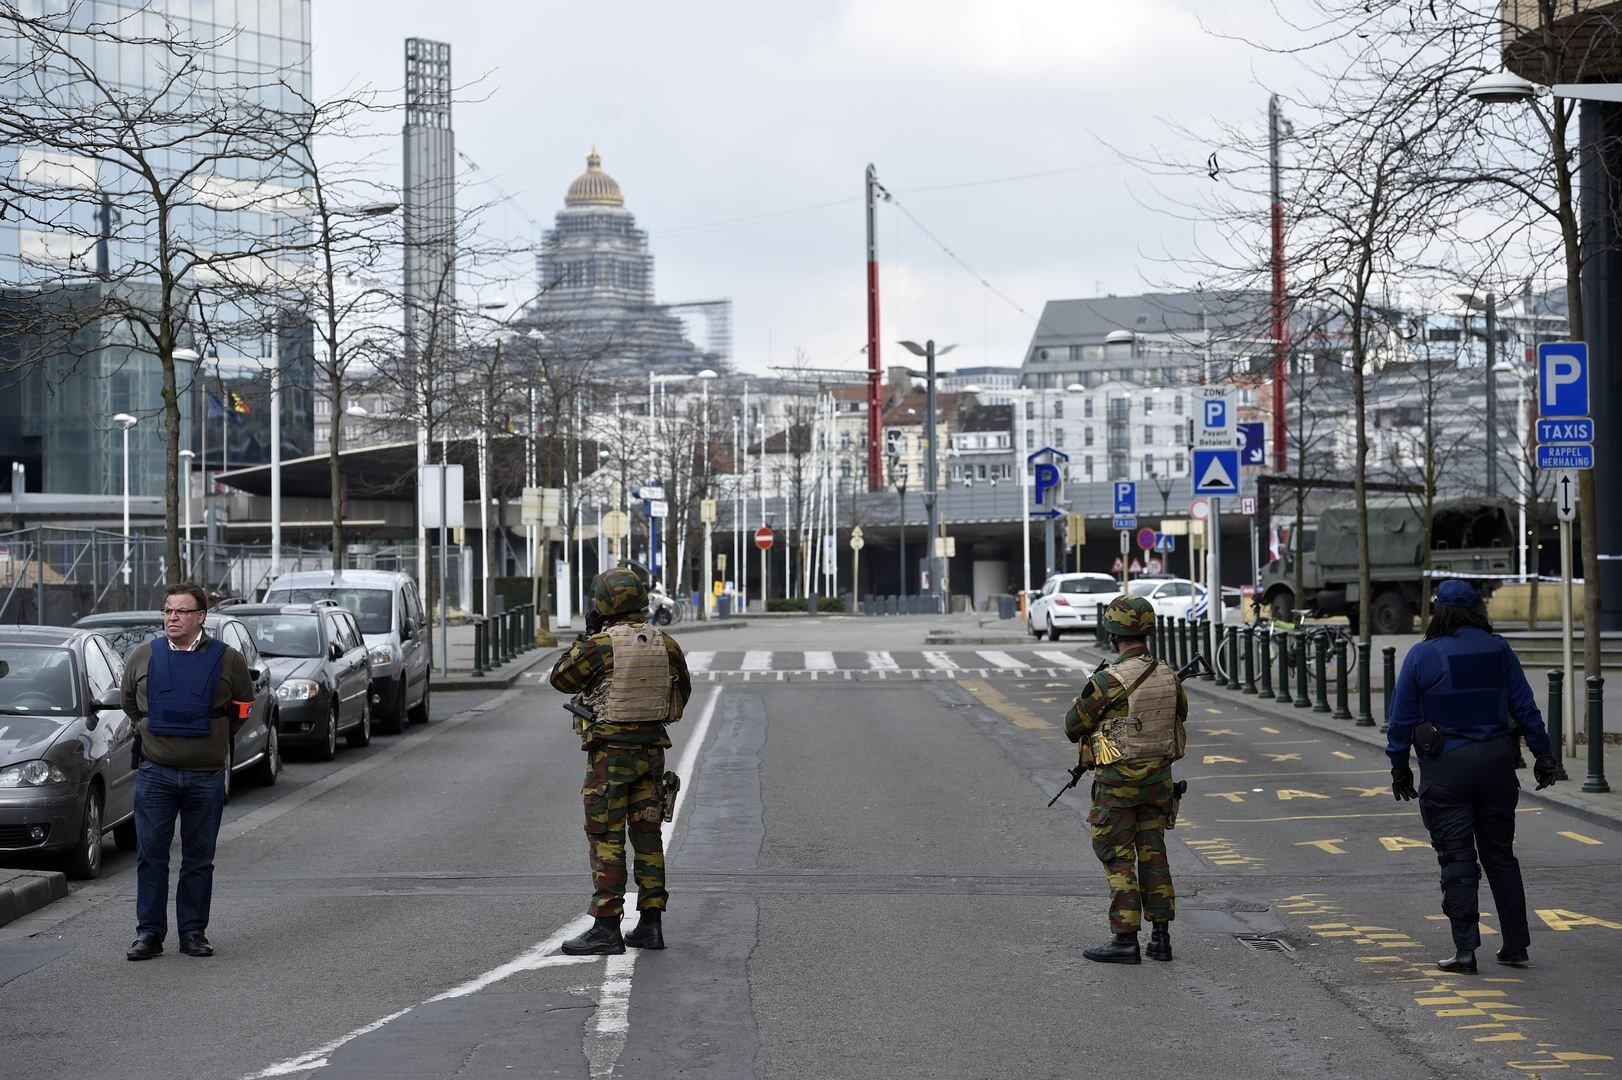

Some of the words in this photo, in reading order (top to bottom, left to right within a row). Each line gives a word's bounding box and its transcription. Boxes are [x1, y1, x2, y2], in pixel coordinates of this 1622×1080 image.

[1546, 354, 1582, 406] P
[1203, 388, 1226, 397] ZONE
[1207, 403, 1223, 426] P
[1202, 429, 1228, 438] Payant
[1542, 424, 1588, 439] TAXIS
[1199, 439, 1232, 447] Betalend
[1548, 447, 1582, 457] RAPPEL
[1542, 457, 1590, 467] HERHALING
[1035, 463, 1059, 505] P
[1117, 483, 1131, 501] P
[1244, 500, 1253, 512] H
